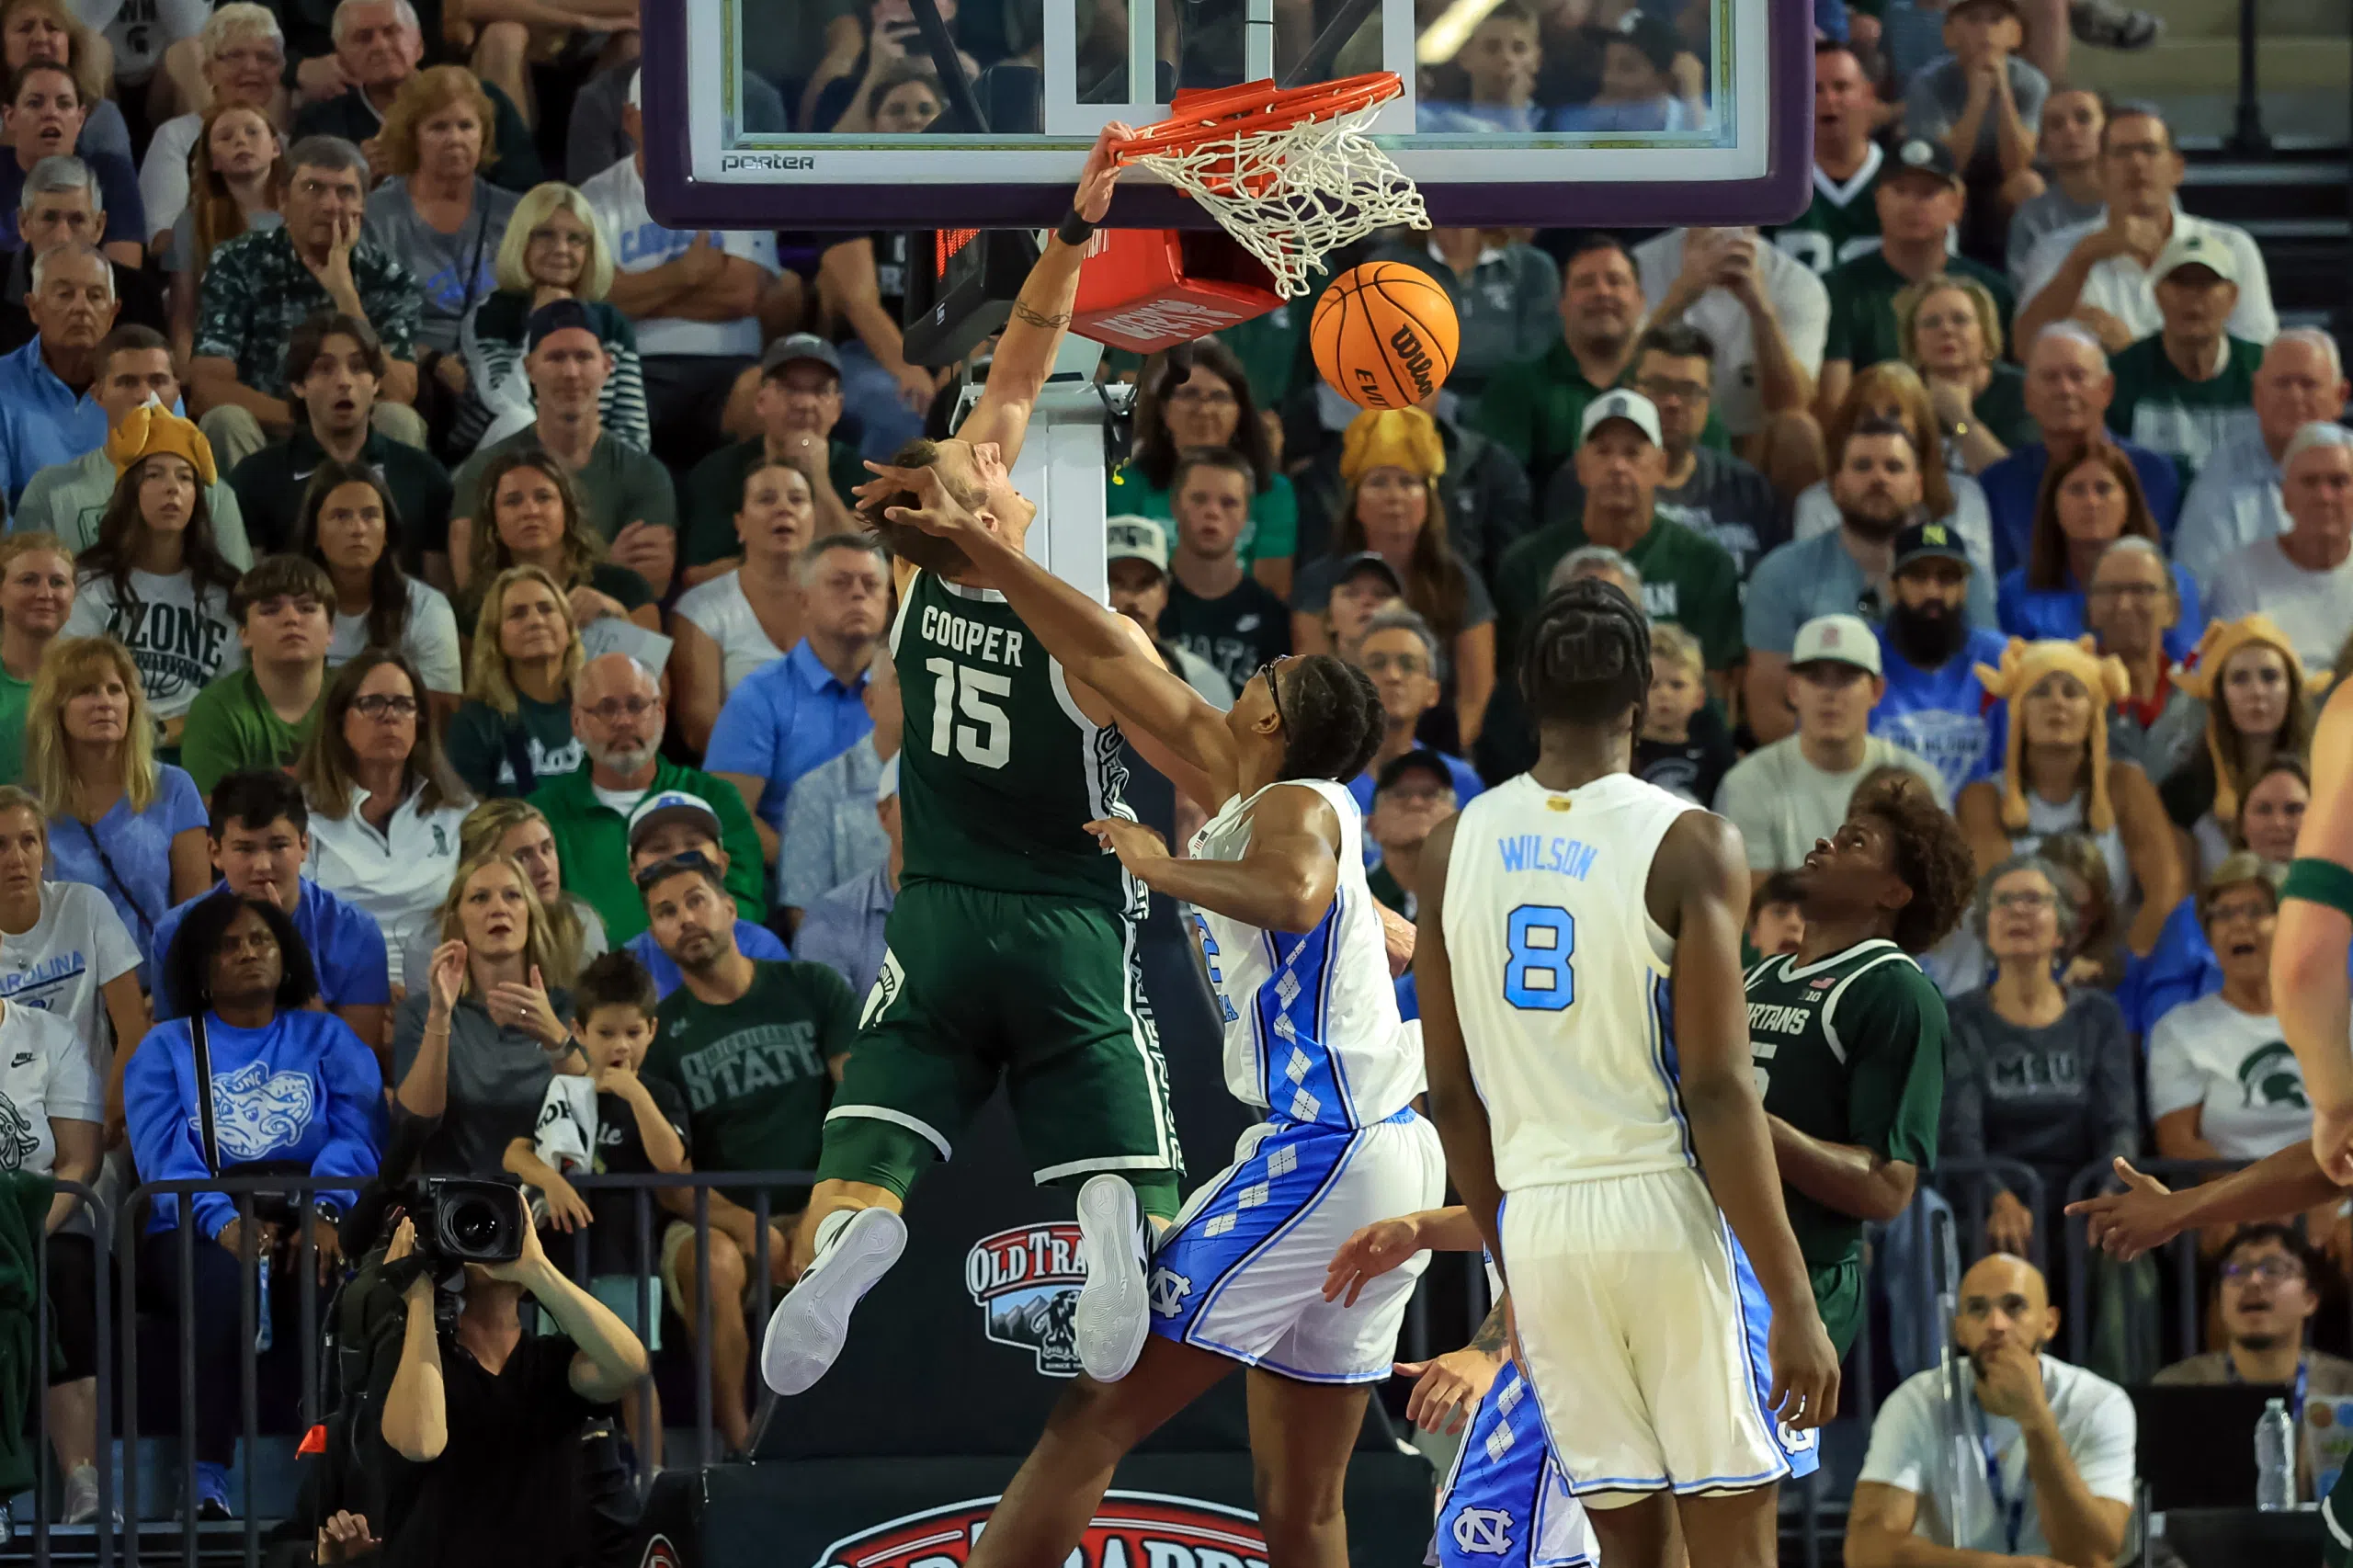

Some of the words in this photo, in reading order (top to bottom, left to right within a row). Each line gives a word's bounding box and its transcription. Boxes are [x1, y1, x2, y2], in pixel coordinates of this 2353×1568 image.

[1390, 322, 1435, 402] Wilson
[921, 605, 1023, 667] COOPER
[926, 657, 1012, 769] 15
[1497, 835, 1597, 881] WILSON
[1503, 903, 1574, 1012] 8
[1746, 1003, 1811, 1035] RTANS
[680, 1020, 824, 1112] STATE
[969, 1246, 1029, 1292] OLD
